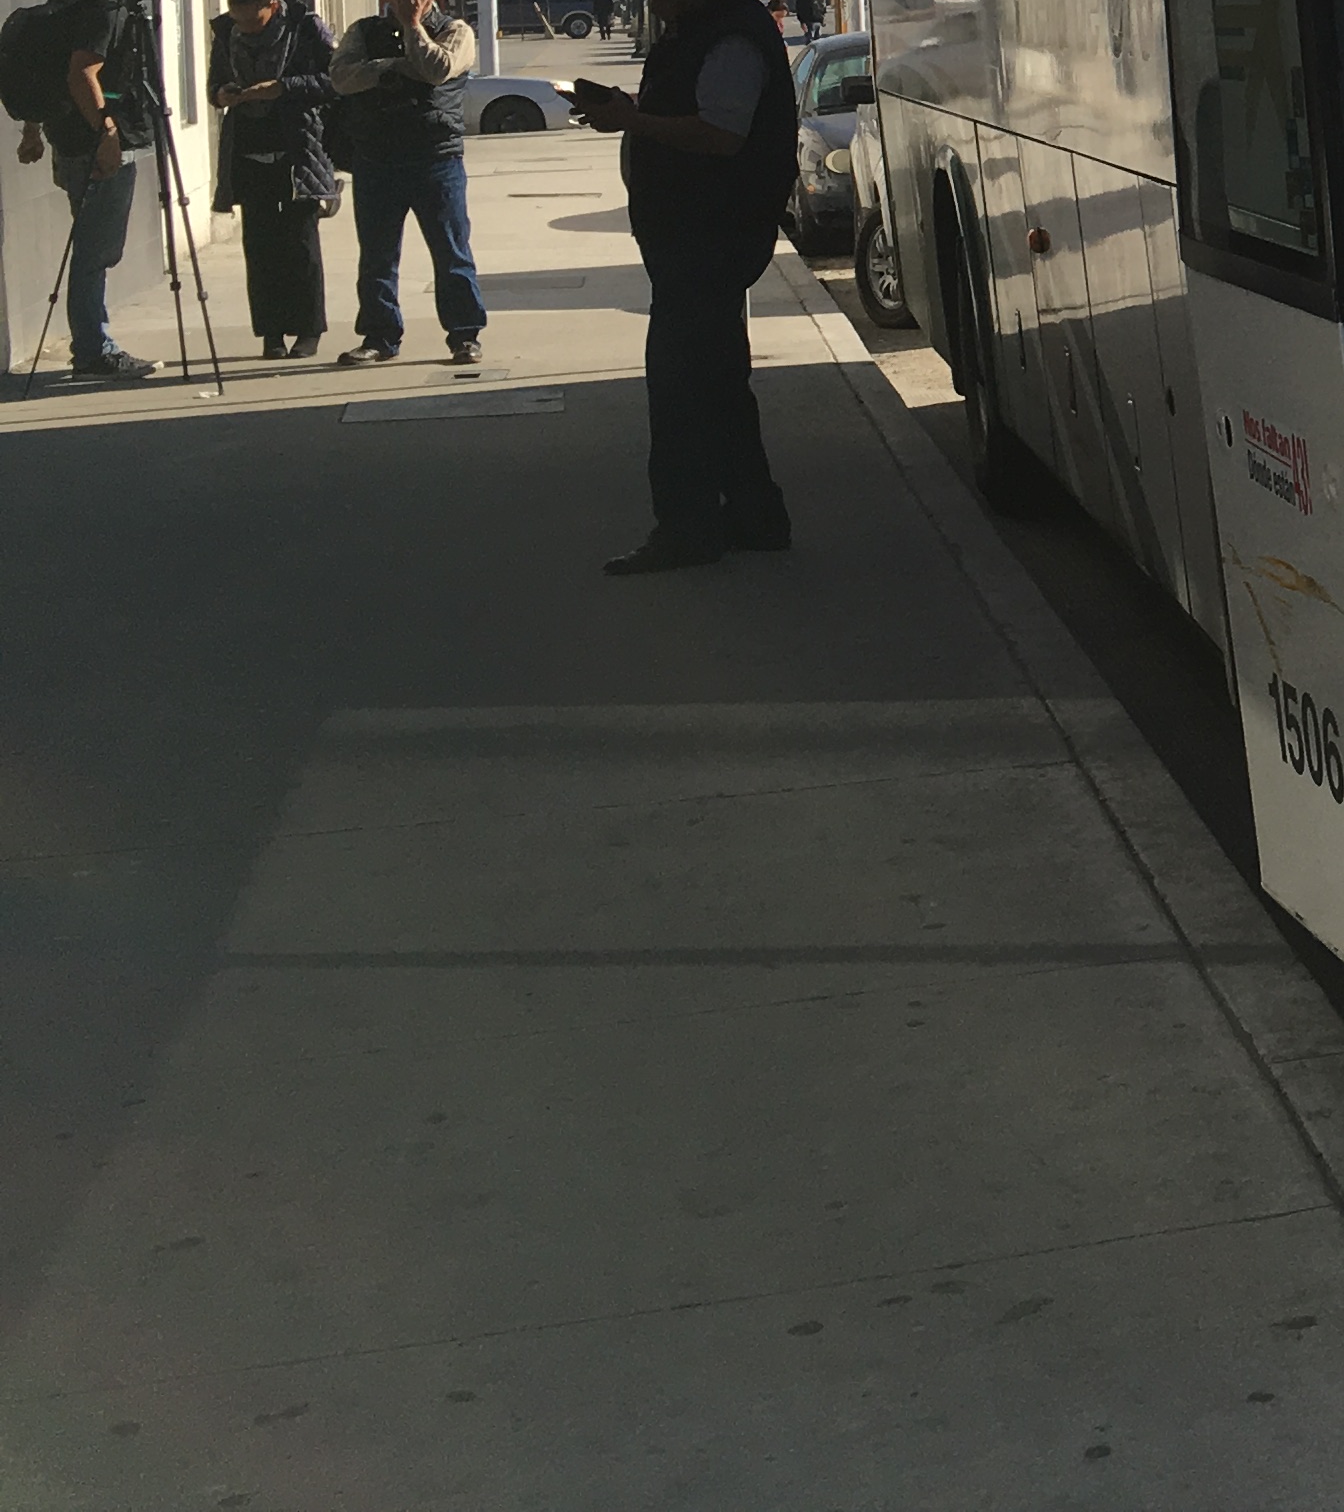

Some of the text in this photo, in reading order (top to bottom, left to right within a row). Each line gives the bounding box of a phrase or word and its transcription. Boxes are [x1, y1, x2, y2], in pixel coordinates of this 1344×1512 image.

[1243, 408, 1262, 443] Nos
[1262, 418, 1292, 461] faltan
[1268, 672, 1344, 805] 1506
